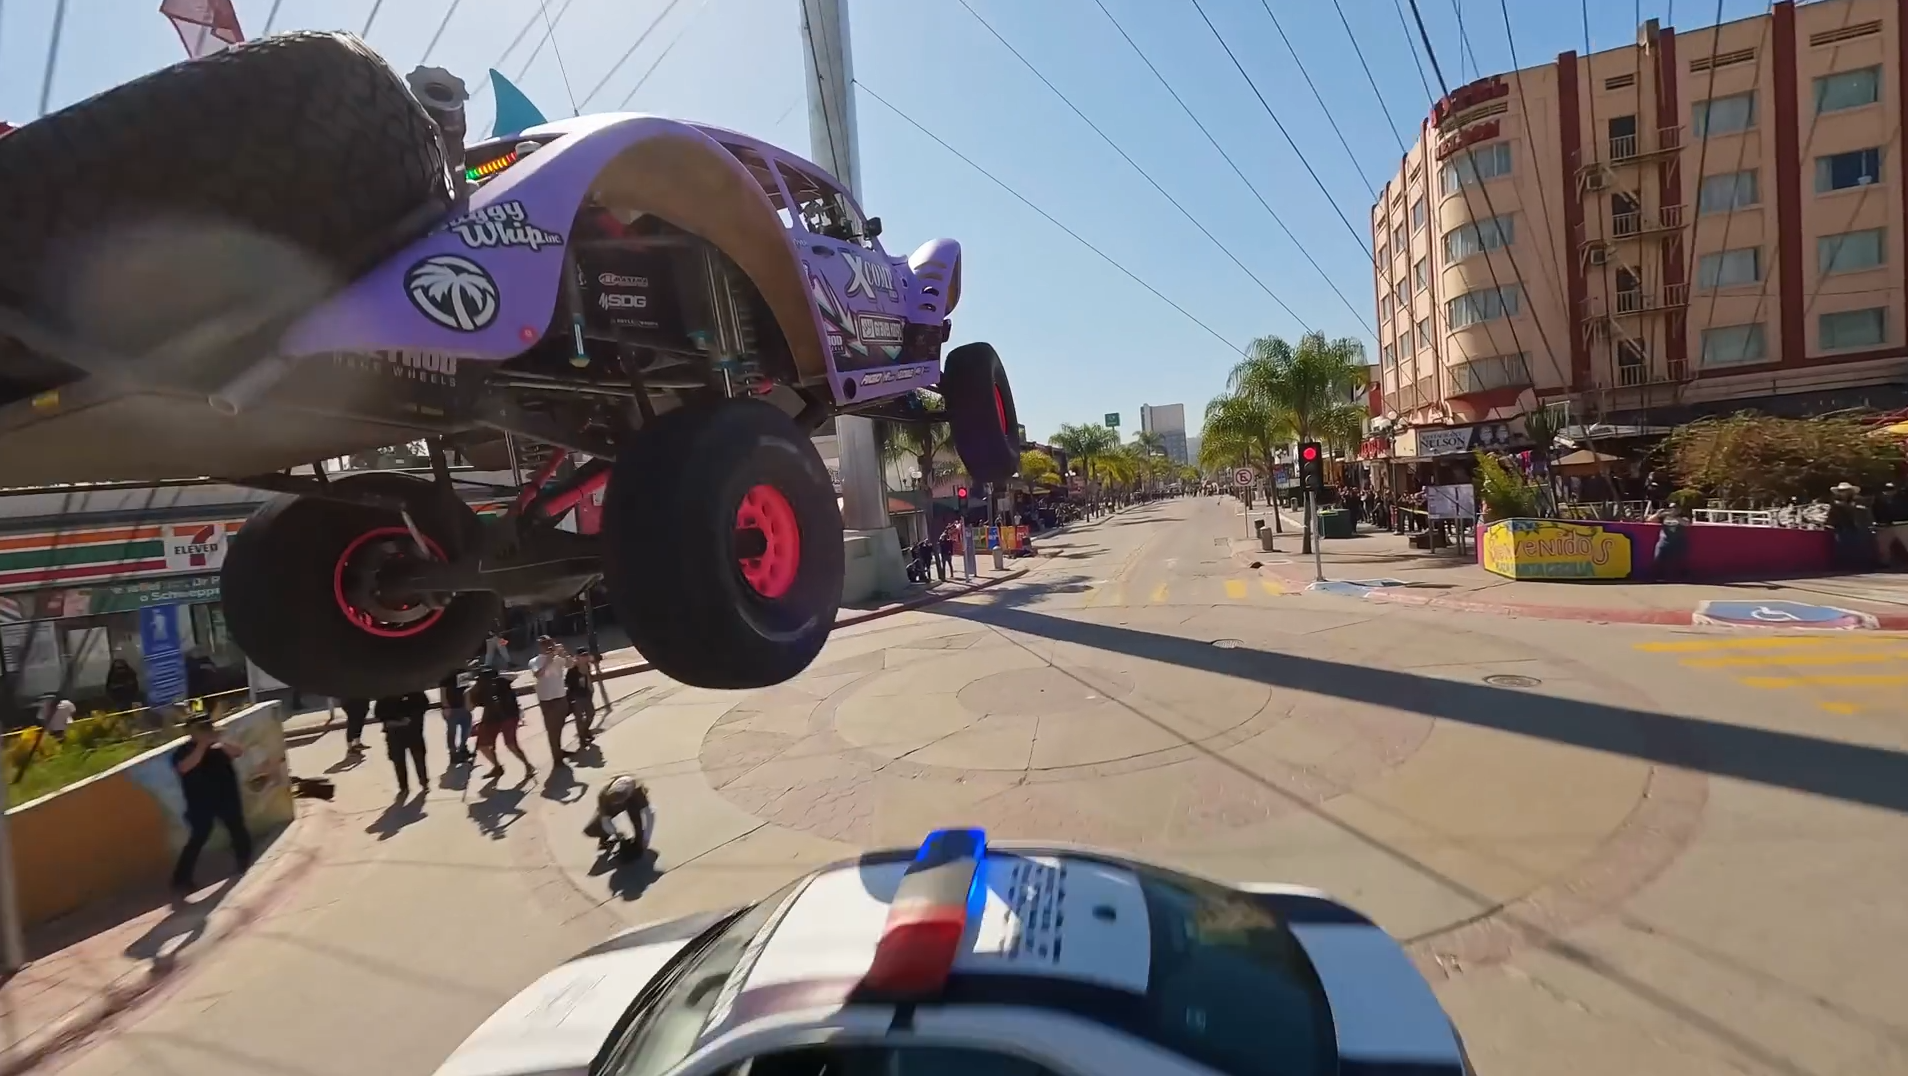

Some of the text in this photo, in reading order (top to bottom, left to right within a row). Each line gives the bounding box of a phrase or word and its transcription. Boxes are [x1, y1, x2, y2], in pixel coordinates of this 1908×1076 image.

[451, 220, 545, 250] Whip
[608, 294, 646, 308] SDG
[1420, 437, 1466, 449] NELSON
[174, 525, 214, 566] 7
